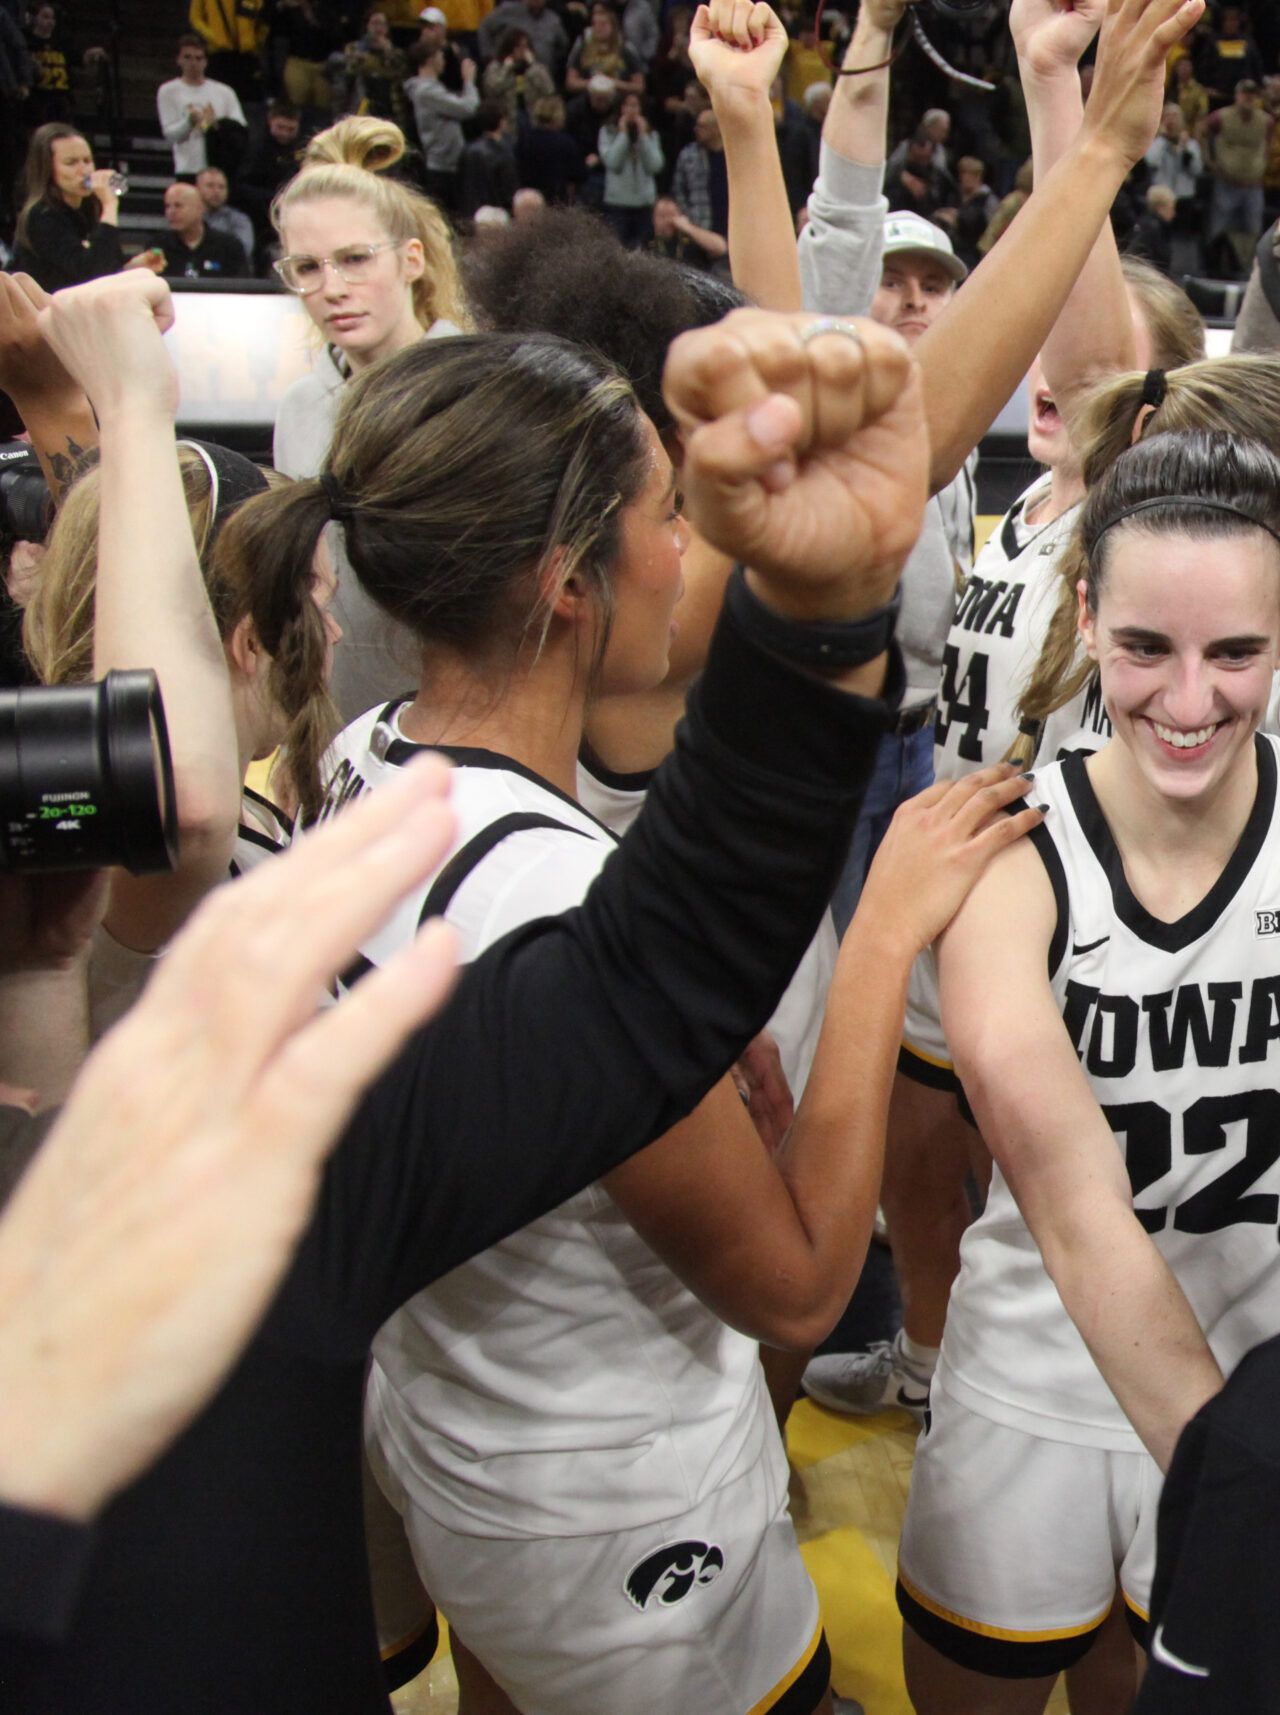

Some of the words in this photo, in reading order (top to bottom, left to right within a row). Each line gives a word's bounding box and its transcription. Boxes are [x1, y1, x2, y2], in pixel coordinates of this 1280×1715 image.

[0, 450, 29, 460] Canon
[40, 804, 97, 818] 20-120
[56, 819, 81, 830] 4K
